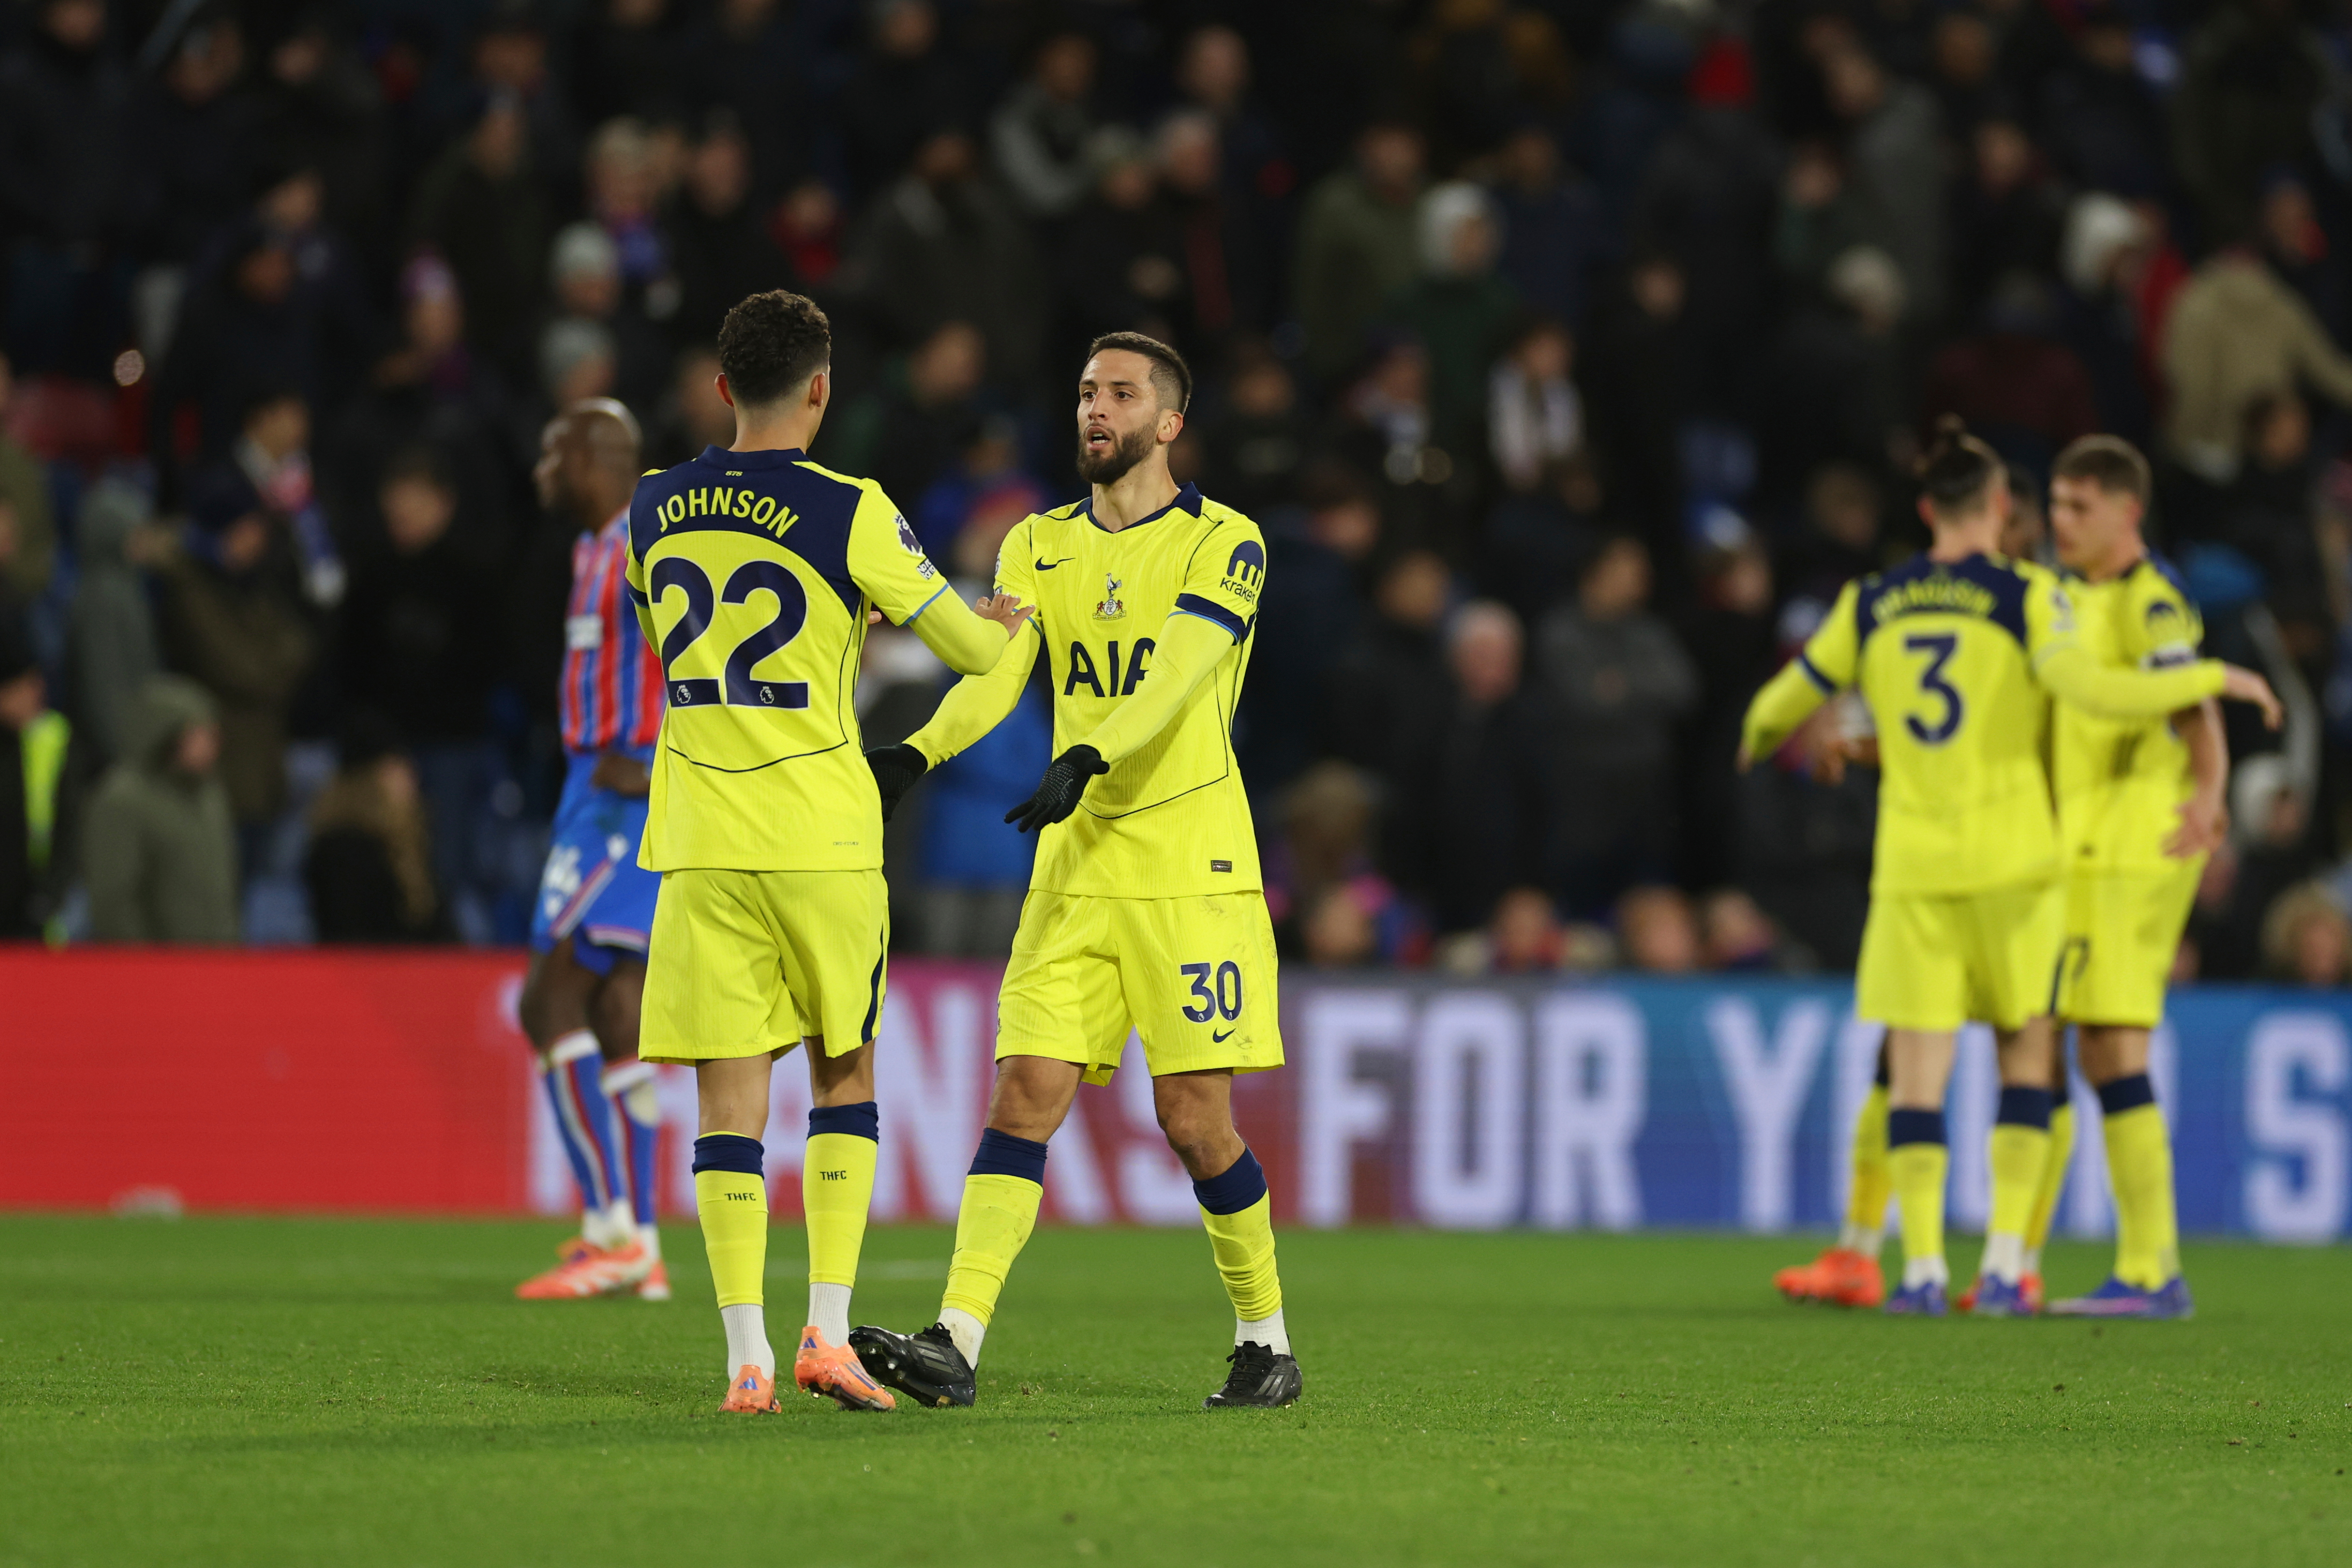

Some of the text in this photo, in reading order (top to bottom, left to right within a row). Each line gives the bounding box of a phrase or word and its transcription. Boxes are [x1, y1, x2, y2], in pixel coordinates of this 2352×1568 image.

[657, 486, 799, 539] JOHNSON
[1219, 577, 1255, 605] kraken
[651, 557, 809, 709] 22
[1905, 633, 1963, 744] 3
[1180, 961, 1242, 1023] 30
[1301, 989, 1648, 1231] FOR
[724, 1192, 756, 1201] THFC
[820, 1170, 847, 1181] THFC
